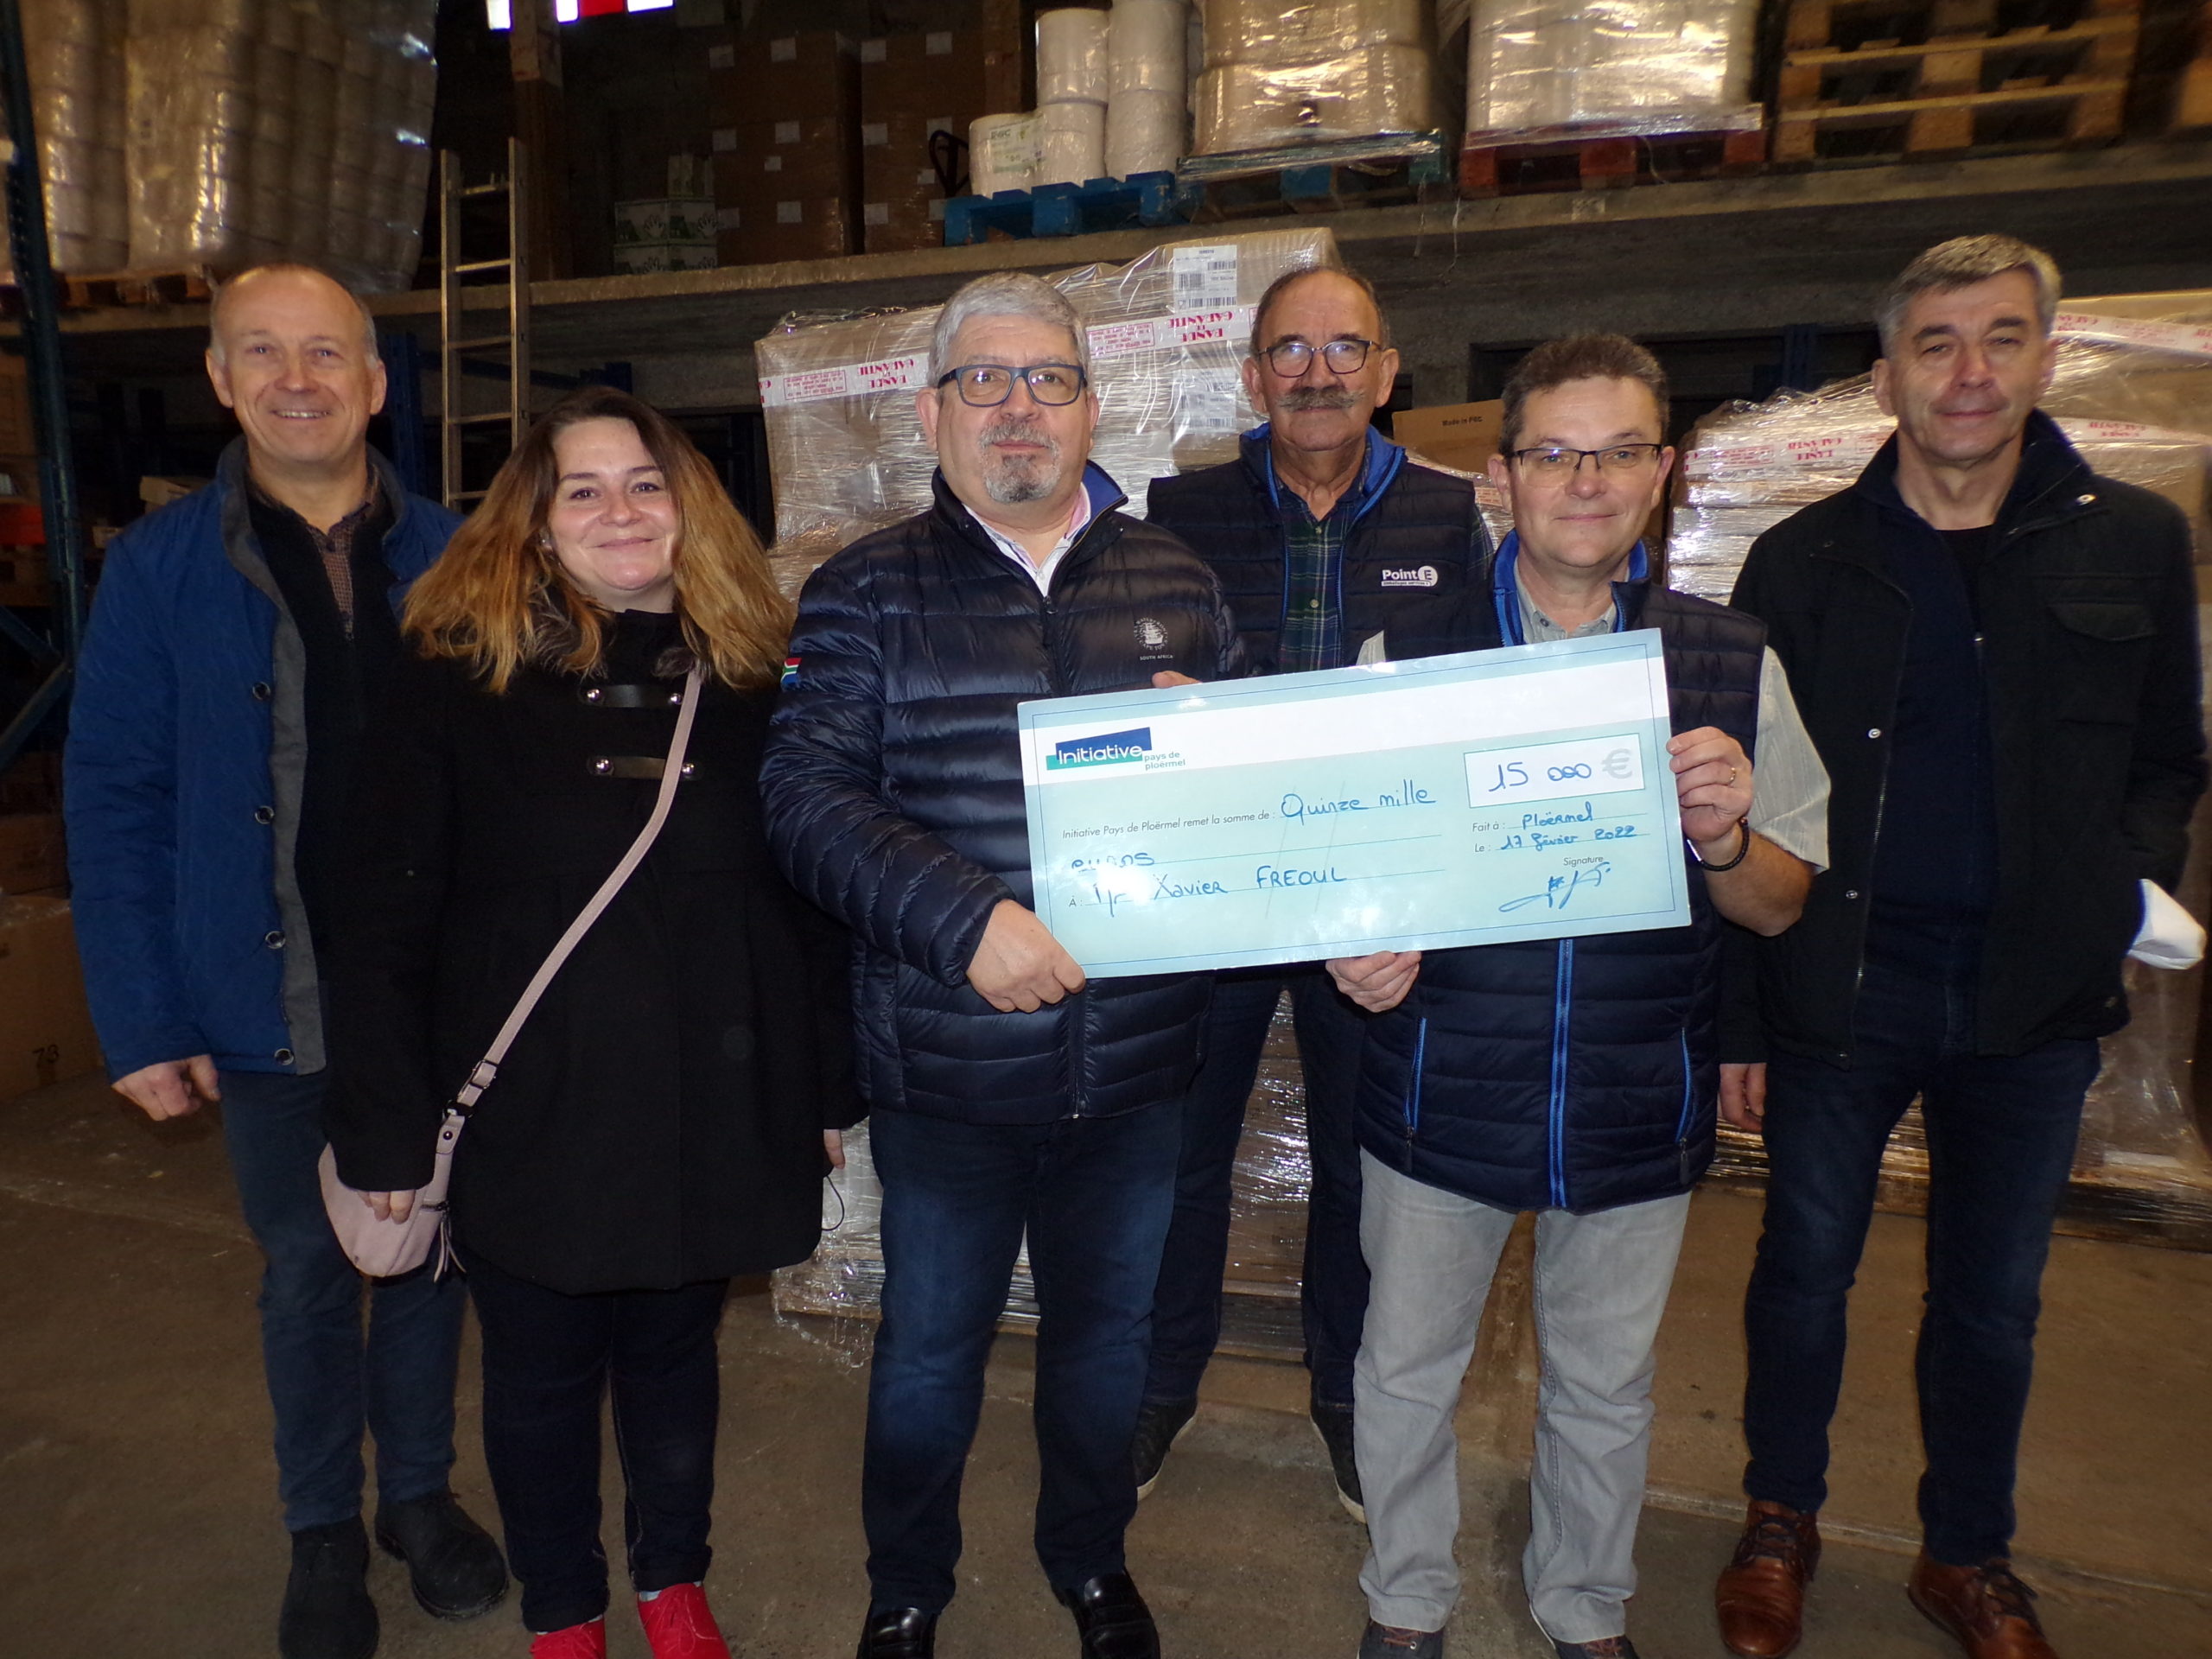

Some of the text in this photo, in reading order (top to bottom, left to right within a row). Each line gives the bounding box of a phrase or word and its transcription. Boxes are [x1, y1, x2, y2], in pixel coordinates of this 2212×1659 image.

[1382, 569, 1418, 581] Point
[1058, 744, 1142, 765] Initiative
[1144, 753, 1166, 763] pays
[1488, 761, 1529, 792] 15
[1281, 779, 1437, 826] Quinze mille
[1062, 827, 1101, 839] Initiative
[1103, 825, 1124, 837] Pays
[1127, 823, 1139, 833] de
[1141, 817, 1180, 831] Ploërmel
[1183, 817, 1210, 827] remet
[1211, 814, 1220, 825] la
[1223, 812, 1255, 823] somme
[1257, 810, 1270, 820] de
[1472, 822, 1491, 833] Fait
[1492, 821, 1499, 830] à
[1474, 842, 1484, 853] Le
[1500, 835, 1522, 850] 17
[1594, 825, 1637, 841] 2022
[1563, 855, 1604, 868] Signature
[1153, 873, 1229, 900] Xavier
[1256, 865, 1347, 889] FREOUL
